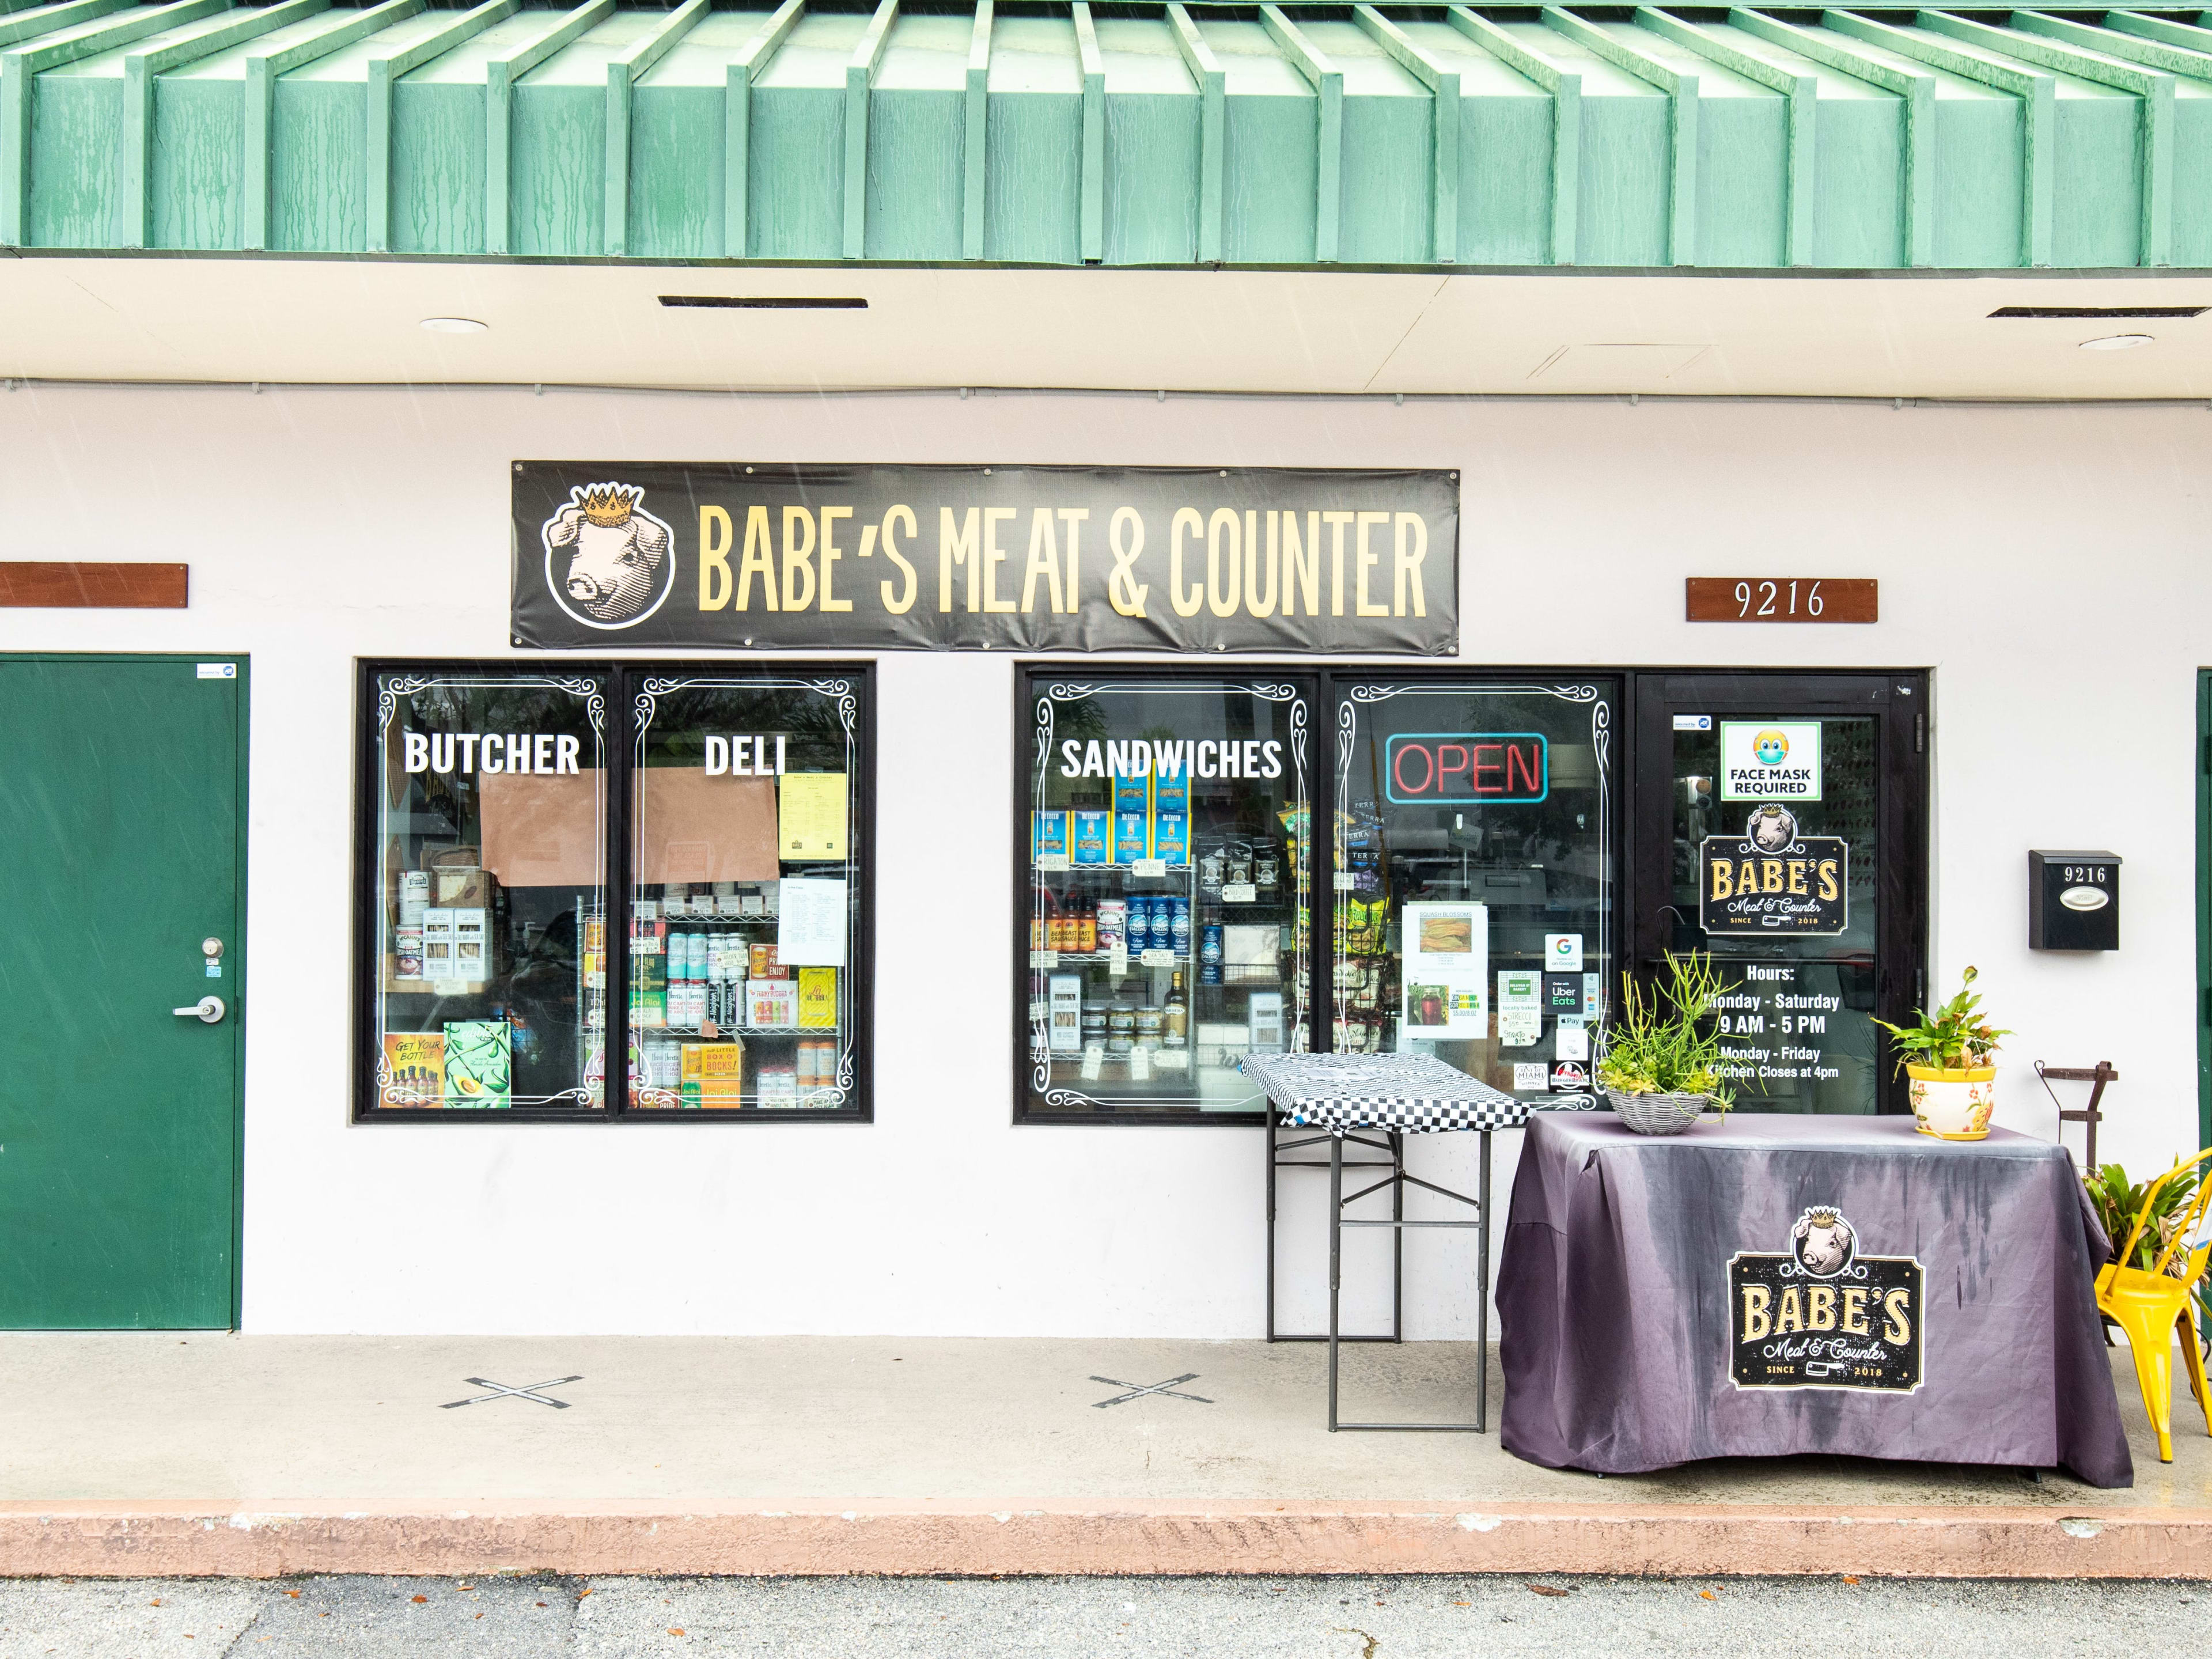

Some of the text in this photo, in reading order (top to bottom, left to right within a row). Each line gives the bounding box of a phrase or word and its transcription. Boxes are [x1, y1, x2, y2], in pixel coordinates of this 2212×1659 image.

[698, 505, 1428, 619] BABE'S MEAT & COUNTER
[1735, 581, 1823, 618] 9216
[405, 733, 579, 774] BUTCHER
[705, 736, 785, 775] DELI
[1061, 739, 1282, 778] SANDWICHES
[1394, 744, 1540, 794] OPEN
[1730, 769, 1811, 780] FACE MASK
[1734, 782, 1807, 795] REQUIRED
[1361, 813, 1385, 824] TERRA
[1346, 831, 1369, 839] ERRA
[1710, 858, 1839, 902] BABE'S
[2065, 866, 2105, 882] 9216
[1728, 898, 1821, 914] Meat & Counter
[769, 967, 786, 975] ENJOY
[1747, 965, 1794, 980] Hours:
[668, 990, 683, 1000] Heretic
[688, 990, 703, 999] Heretic
[1552, 987, 1575, 996] Uber
[645, 998, 660, 1006] Alai
[1552, 997, 1575, 1005] Eats
[1775, 993, 1839, 1012] Saturday
[1720, 1016, 1730, 1033] 9
[1736, 1016, 1763, 1033] AM
[1782, 1016, 1791, 1033] 5
[1798, 1016, 1825, 1033] PM
[396, 1039, 441, 1052] GET YOUR
[400, 1051, 435, 1061] BOTTLE
[1720, 1046, 1770, 1063] Monday
[1781, 1046, 1820, 1063] Friday
[707, 1060, 738, 1071] BOCKS!
[1706, 1066, 1839, 1081] Kitchen Closes at 4pm
[1741, 1283, 1911, 1346] BABE'S
[1763, 1338, 1888, 1361] Meat & Counter
[1767, 1365, 1795, 1374] SINCE
[1854, 1366, 1883, 1377] 2018
